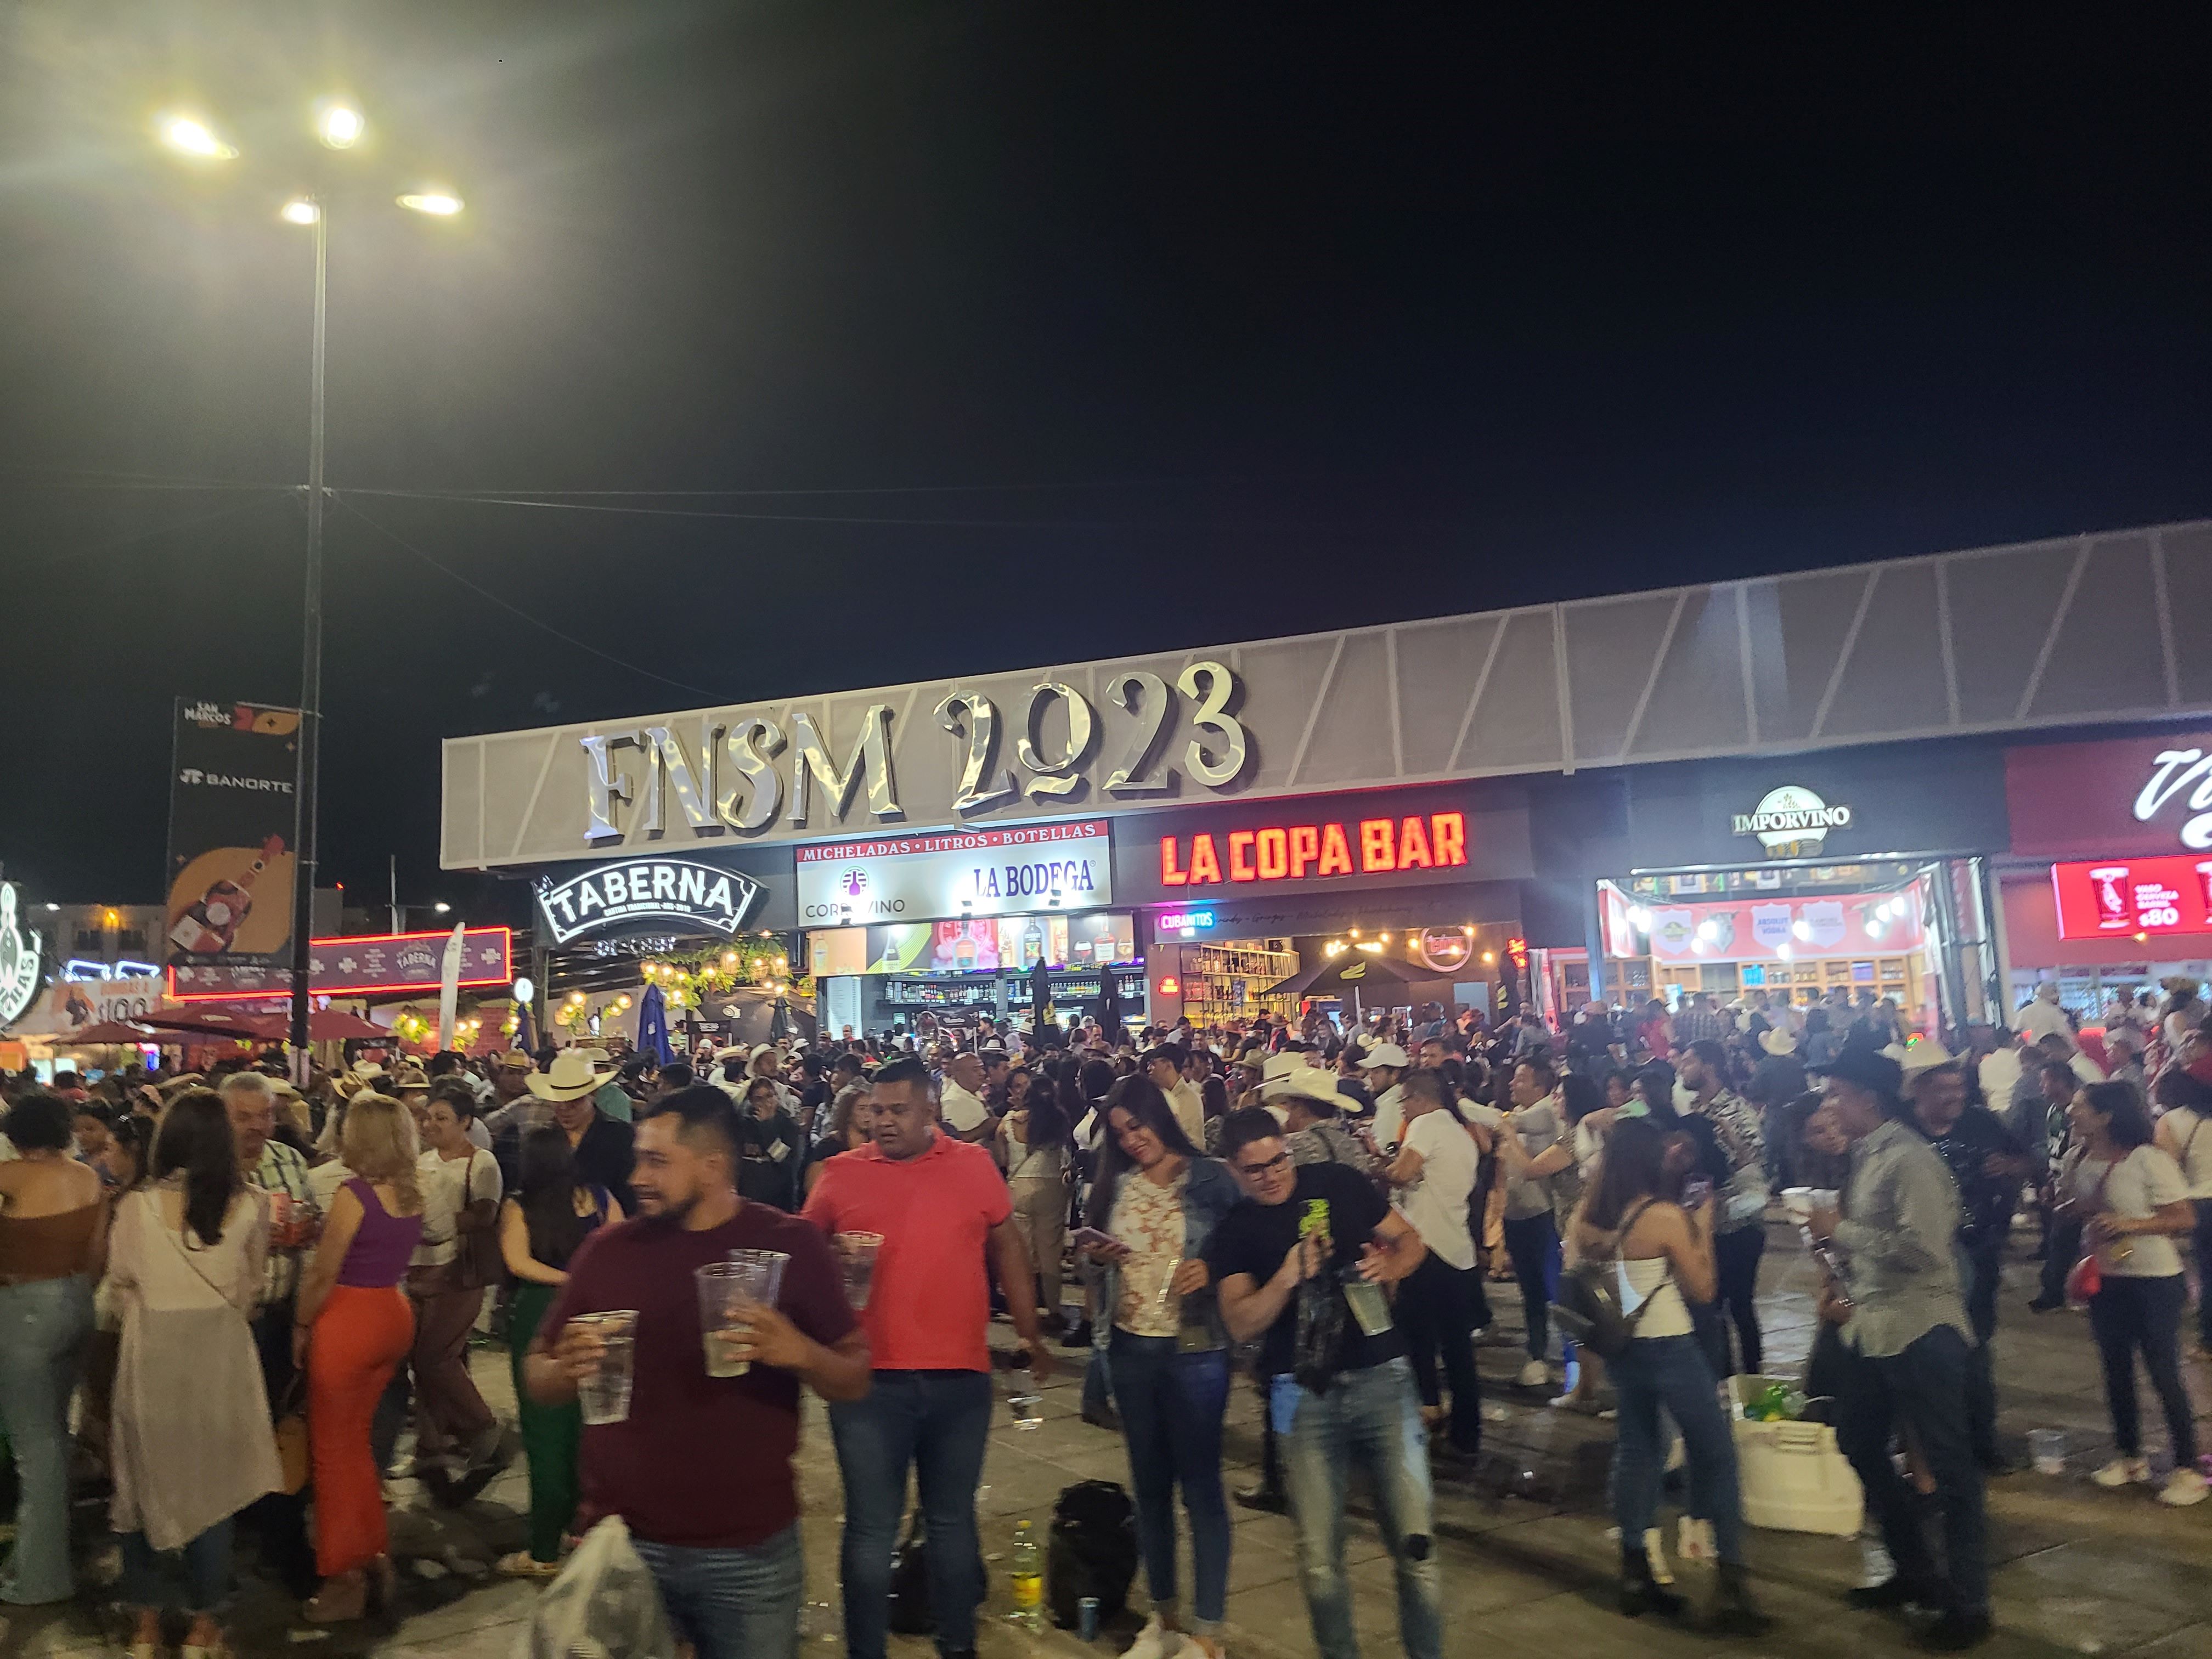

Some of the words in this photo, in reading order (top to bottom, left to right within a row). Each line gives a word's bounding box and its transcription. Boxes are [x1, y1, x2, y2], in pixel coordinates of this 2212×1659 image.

[579, 704, 904, 839] FNSM
[933, 660, 1261, 812] 2023
[206, 773, 293, 793] BANORTE
[1734, 805, 1850, 832] IMPORVINO
[803, 841, 911, 861] MICHELADAS
[924, 834, 988, 851] LITROS
[1002, 823, 1096, 844] BOTELLAS
[1161, 833, 1223, 886] LA
[1228, 822, 1354, 883] COPA
[1359, 811, 1468, 874] BAR
[552, 866, 734, 923] TABERNA
[974, 867, 1001, 897] LA
[1005, 859, 1094, 896] BODEGA
[1161, 911, 1213, 929] CUBANITOS
[2138, 906, 2179, 927] $80
